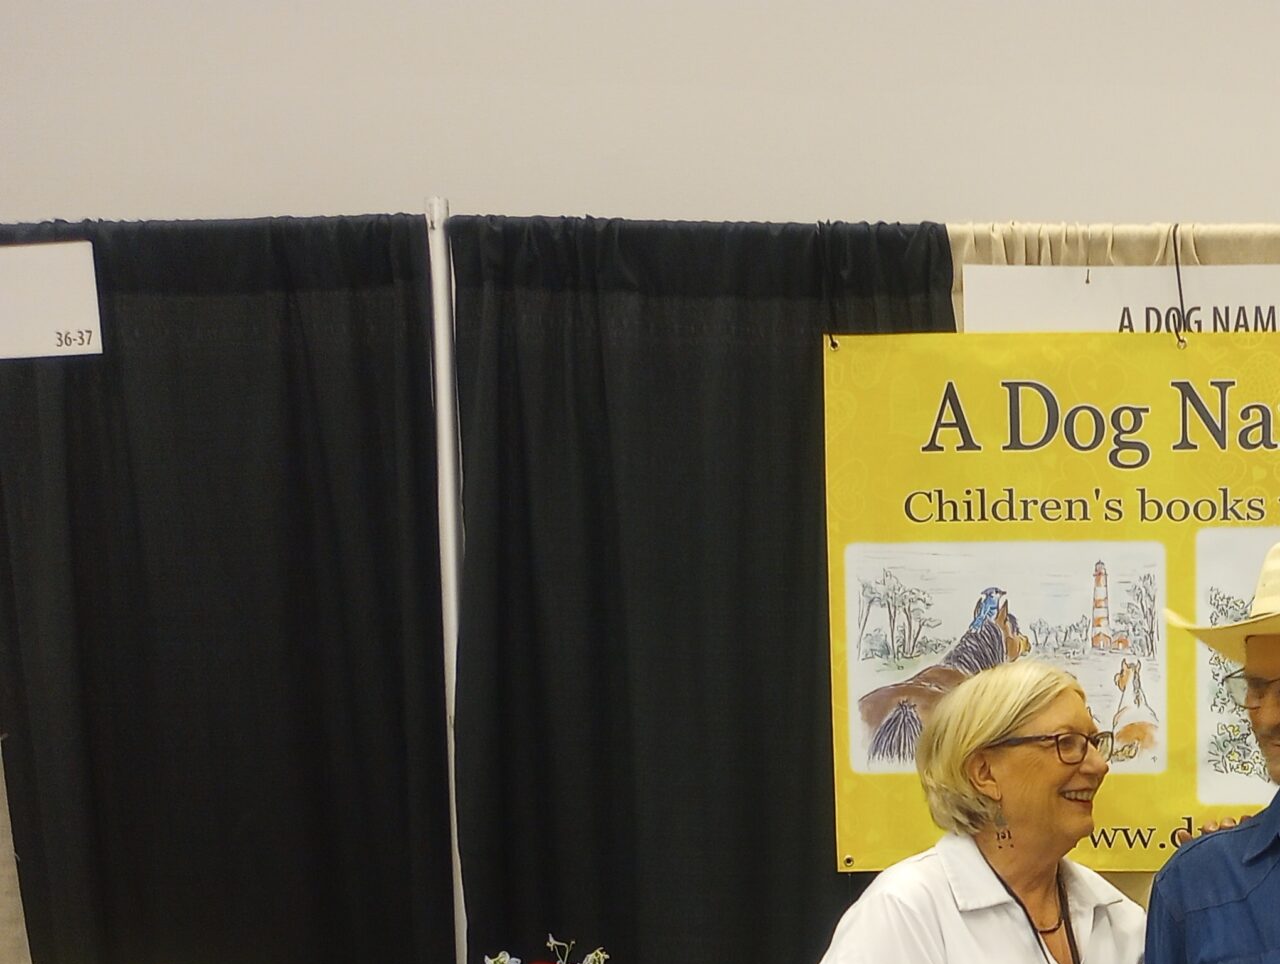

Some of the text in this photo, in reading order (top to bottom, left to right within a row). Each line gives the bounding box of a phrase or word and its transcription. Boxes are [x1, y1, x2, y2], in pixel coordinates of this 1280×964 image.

[1118, 306, 1134, 333] A
[1145, 306, 1202, 333] DOG
[56, 329, 93, 347] 36-37
[921, 381, 982, 452] A
[1001, 380, 1151, 470] Dog
[904, 488, 1124, 523] Children's
[1140, 487, 1265, 523] books
